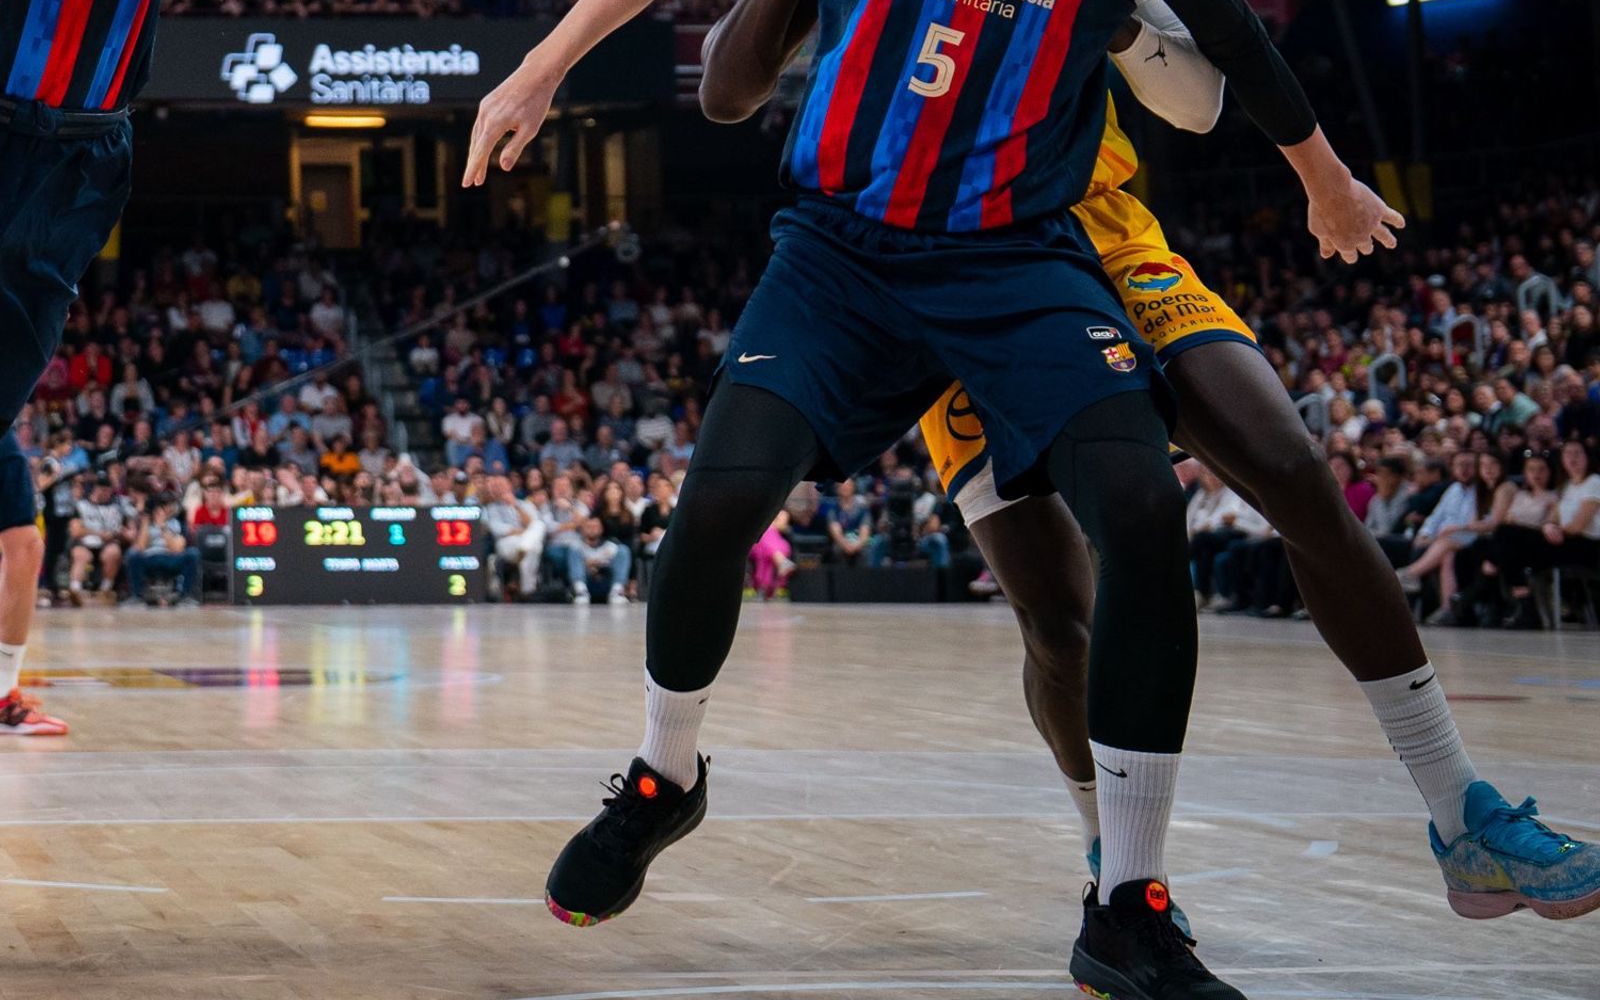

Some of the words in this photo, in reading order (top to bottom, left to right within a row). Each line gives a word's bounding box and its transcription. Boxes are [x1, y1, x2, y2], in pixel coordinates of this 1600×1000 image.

[308, 43, 480, 76] Assistència
[907, 22, 966, 98] 5
[309, 72, 431, 104] Sanitària
[1144, 309, 1173, 334] del
[303, 520, 366, 546] 2:21
